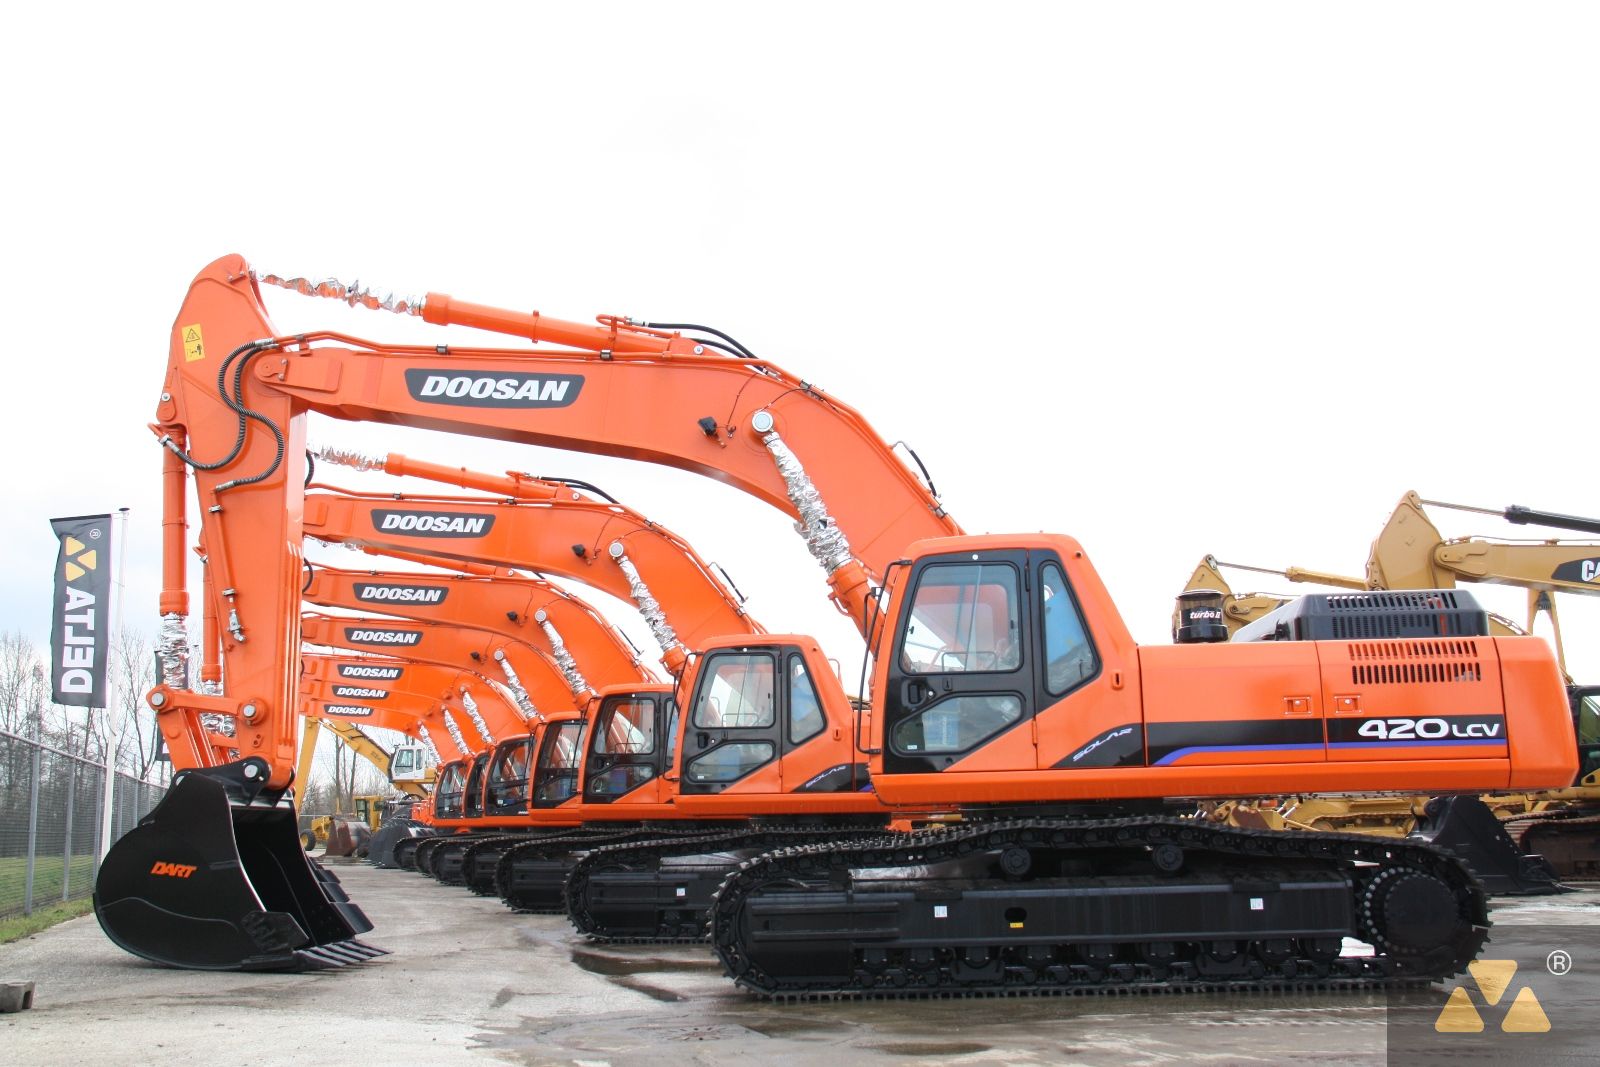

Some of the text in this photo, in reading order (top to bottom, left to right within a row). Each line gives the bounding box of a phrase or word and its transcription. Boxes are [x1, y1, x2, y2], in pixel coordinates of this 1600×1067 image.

[420, 375, 570, 401] DOOSAN
[381, 514, 486, 533] DOOSAN
[361, 586, 442, 602] DOOSAN
[1190, 610, 1214, 619] turbo
[61, 585, 96, 694] DELTA
[351, 630, 418, 644] DOOSAN
[342, 666, 399, 678] DOOSAN
[336, 687, 387, 698] DOOSAN
[327, 706, 371, 715] DOOSAN
[1358, 718, 1499, 739] 420 LCV
[1073, 727, 1133, 762] SOLAR
[151, 861, 197, 878] DART
